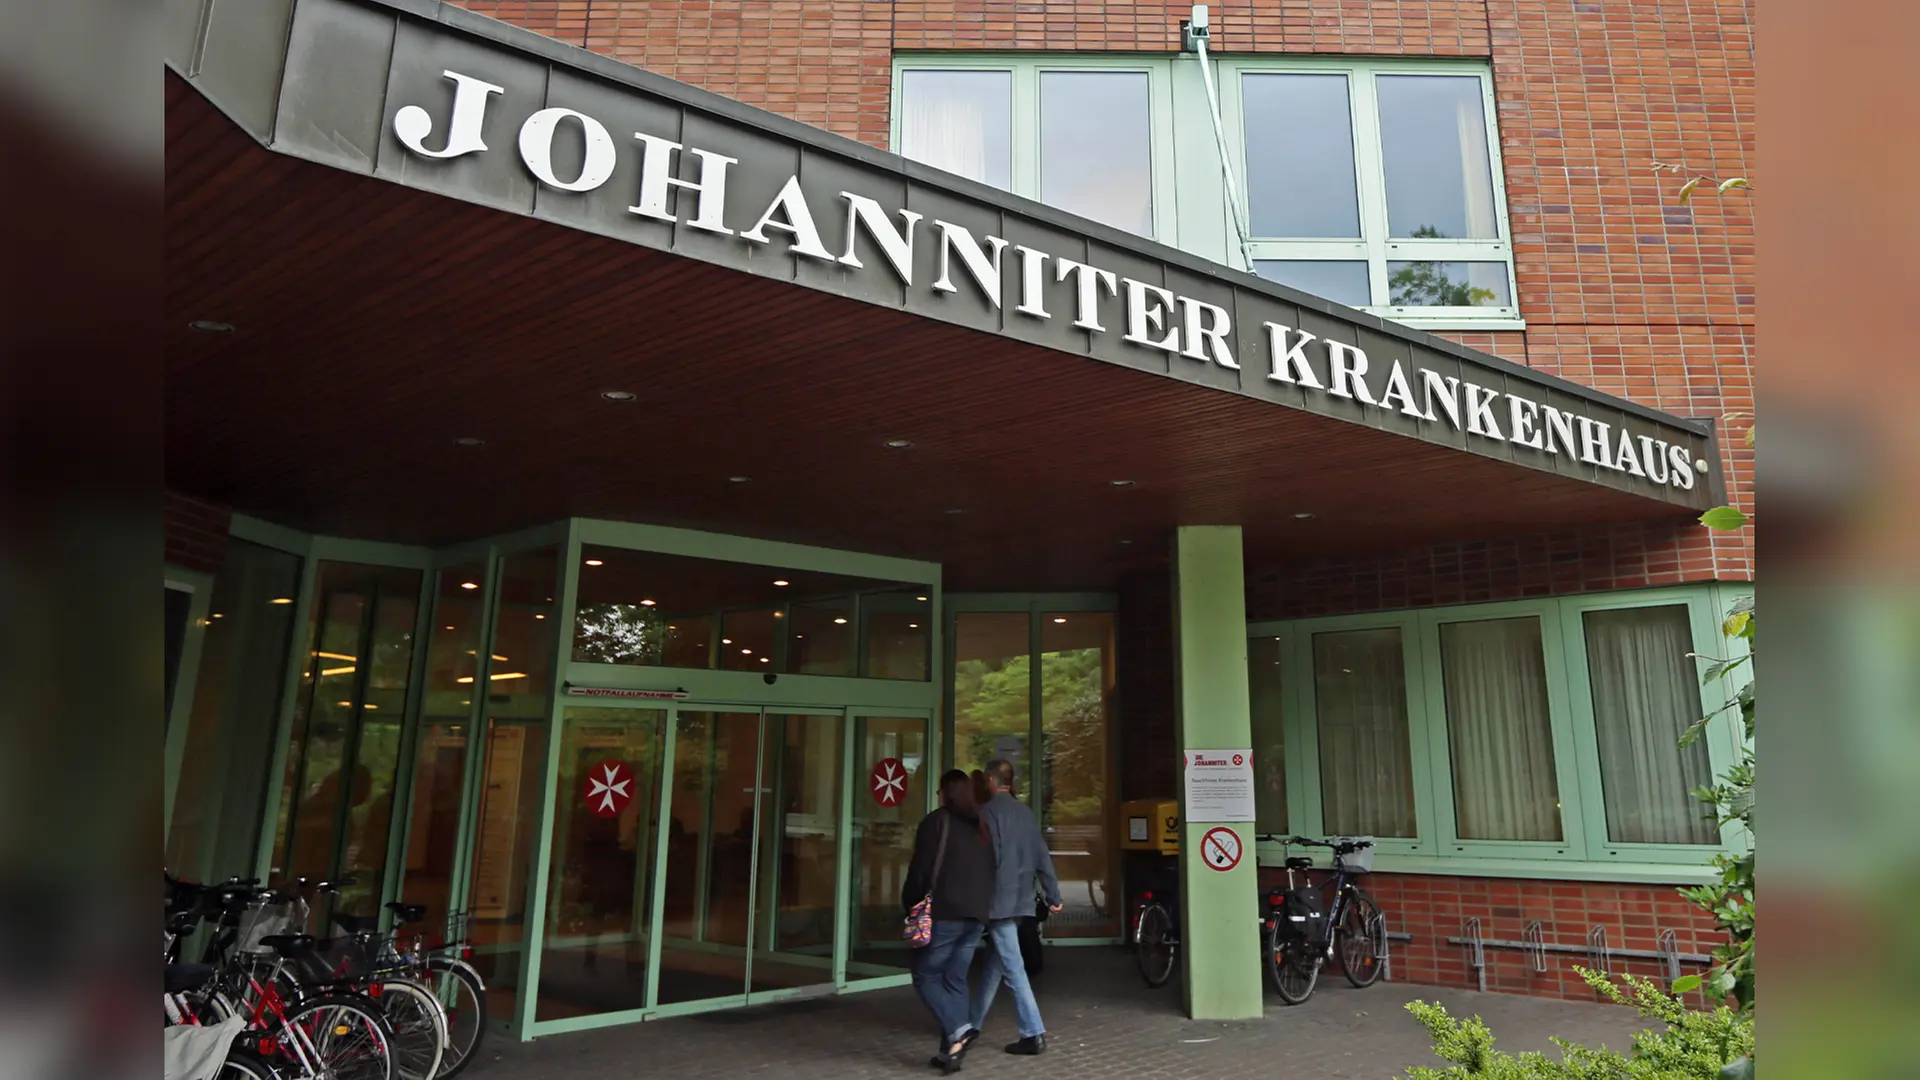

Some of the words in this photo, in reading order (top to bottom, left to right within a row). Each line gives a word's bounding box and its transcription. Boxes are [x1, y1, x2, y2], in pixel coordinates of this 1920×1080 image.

[393, 69, 1241, 371] JOHANNITER
[1263, 321, 1696, 491] KRANKENHAUS
[585, 688, 674, 699] NOTFALLAUFNAHME
